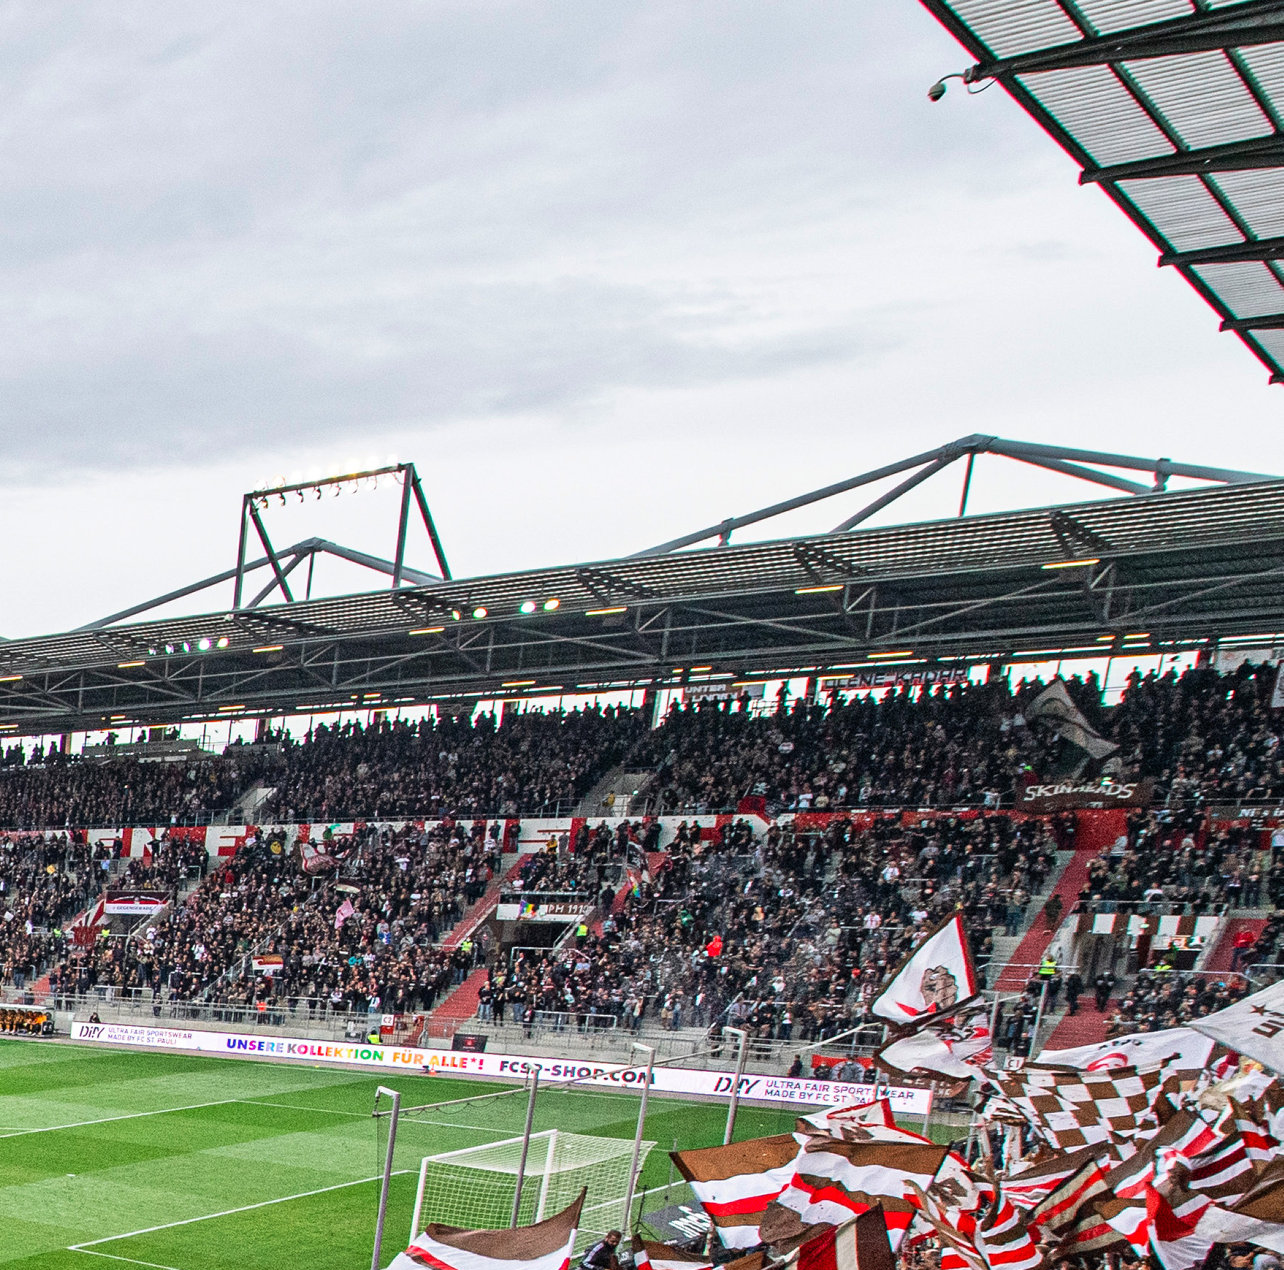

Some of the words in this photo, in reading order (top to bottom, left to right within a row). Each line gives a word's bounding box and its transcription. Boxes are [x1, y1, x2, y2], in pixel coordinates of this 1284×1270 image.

[108, 1027, 129, 1035] ULTRA
[146, 1030, 193, 1039] SPORTSWEAR
[227, 1038, 283, 1053] UNSERE
[287, 1043, 384, 1062] KOLLEKTION
[392, 1049, 424, 1065] FÜR
[764, 1088, 796, 1099] MADE
[799, 1091, 812, 1100] BY
[816, 1092, 829, 1102] FC
[766, 1080, 800, 1090] ULTRA
[804, 1082, 830, 1093] FAIR
[833, 1085, 915, 1100] SPORTWEAR
